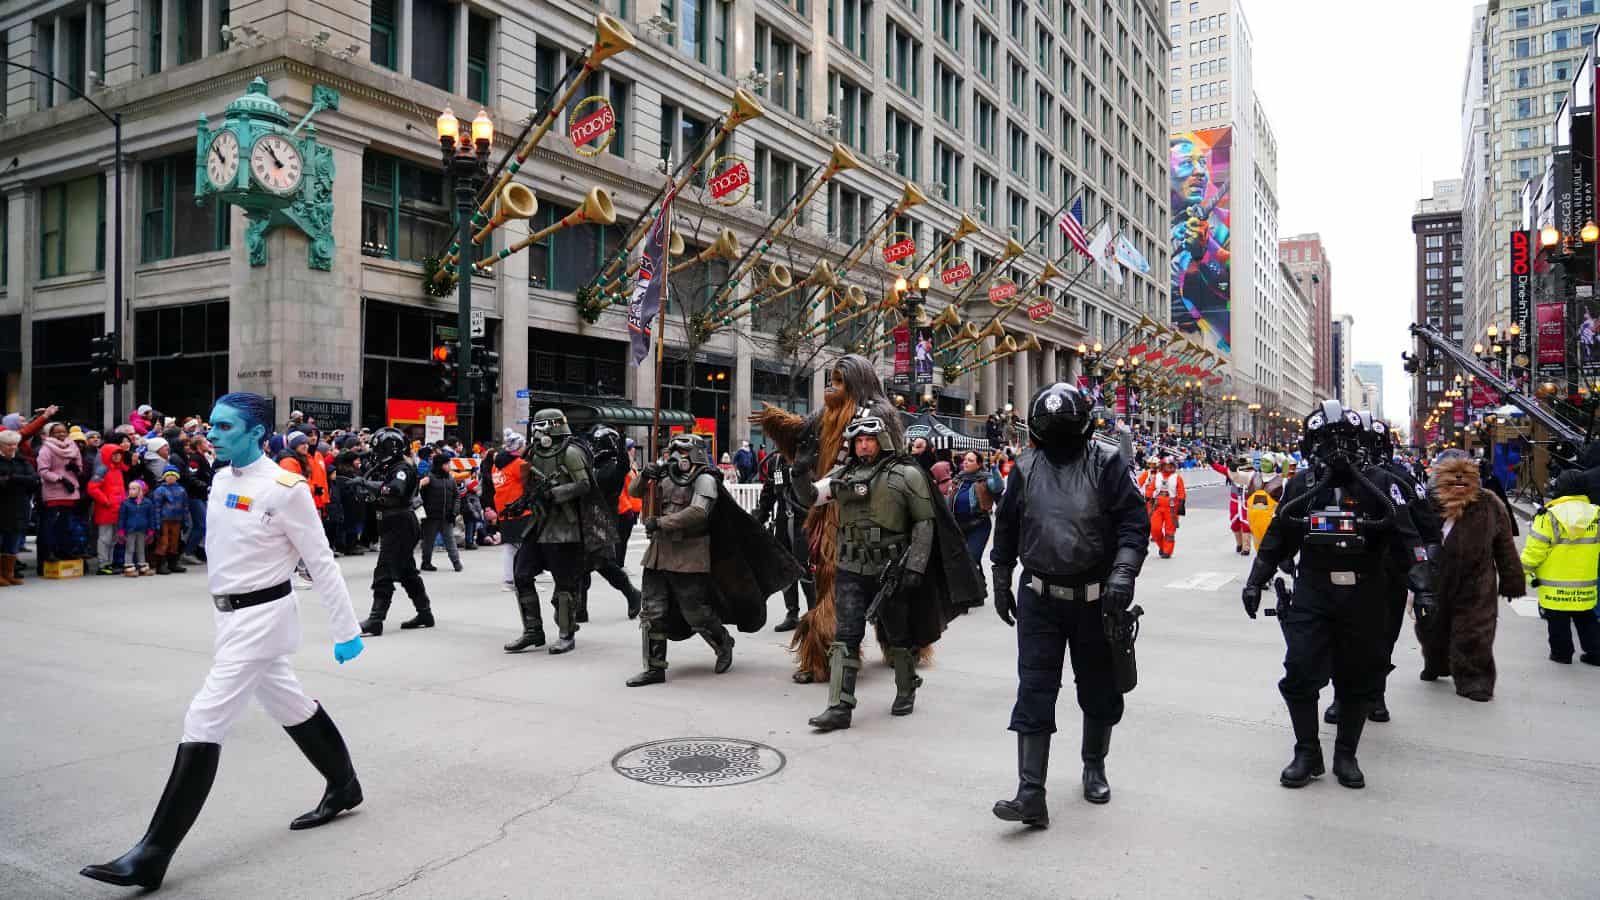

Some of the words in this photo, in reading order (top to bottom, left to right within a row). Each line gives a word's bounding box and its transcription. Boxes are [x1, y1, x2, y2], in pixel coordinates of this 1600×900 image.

[571, 107, 613, 144] macy's
[710, 164, 748, 196] macy's
[1573, 162, 1583, 208] REPUBLIC
[884, 239, 915, 261] macy's
[1513, 231, 1528, 275] amc
[942, 266, 970, 284] macy's
[472, 311, 482, 319] ONE
[298, 370, 318, 379] STATE
[321, 372, 345, 381] STREET
[331, 403, 349, 415] FIELD
